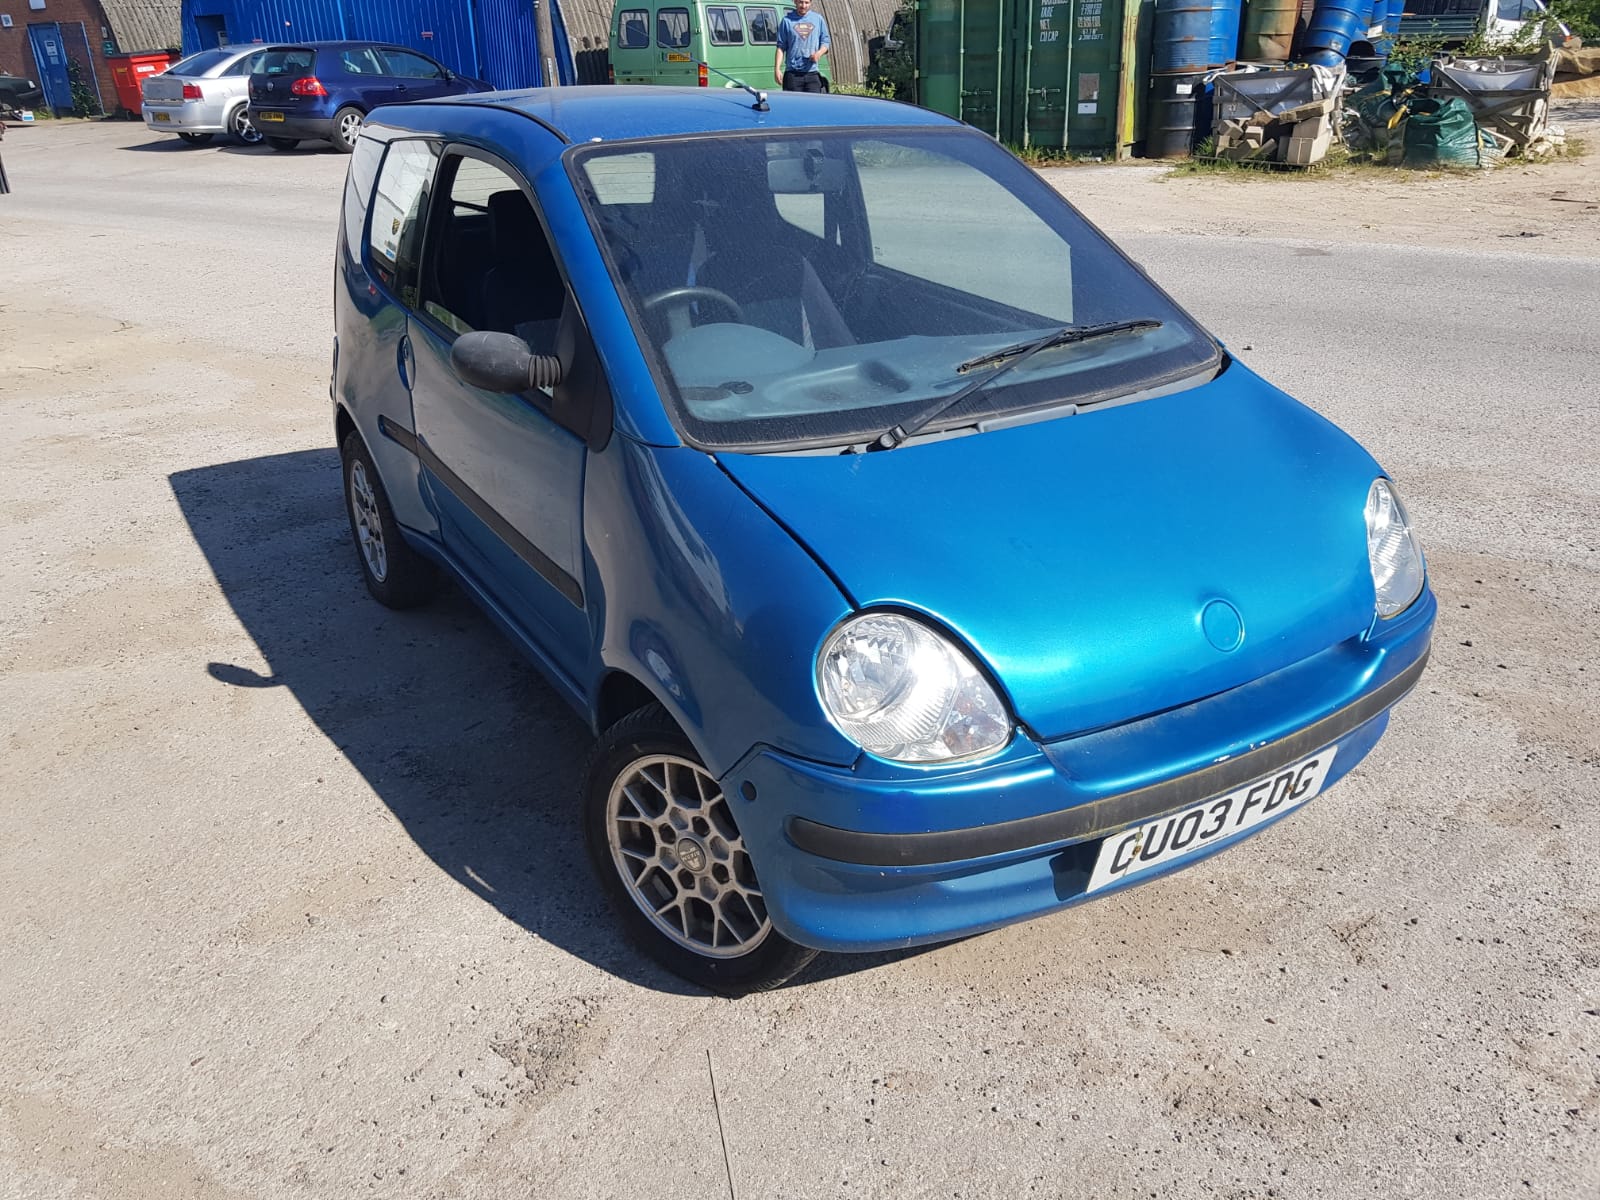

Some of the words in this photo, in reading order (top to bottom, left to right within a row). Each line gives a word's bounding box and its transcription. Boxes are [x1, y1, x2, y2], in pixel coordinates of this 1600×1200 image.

[1048, 30, 1059, 42] CAP
[1110, 798, 1233, 874] CU03
[1235, 759, 1319, 826] FDG
